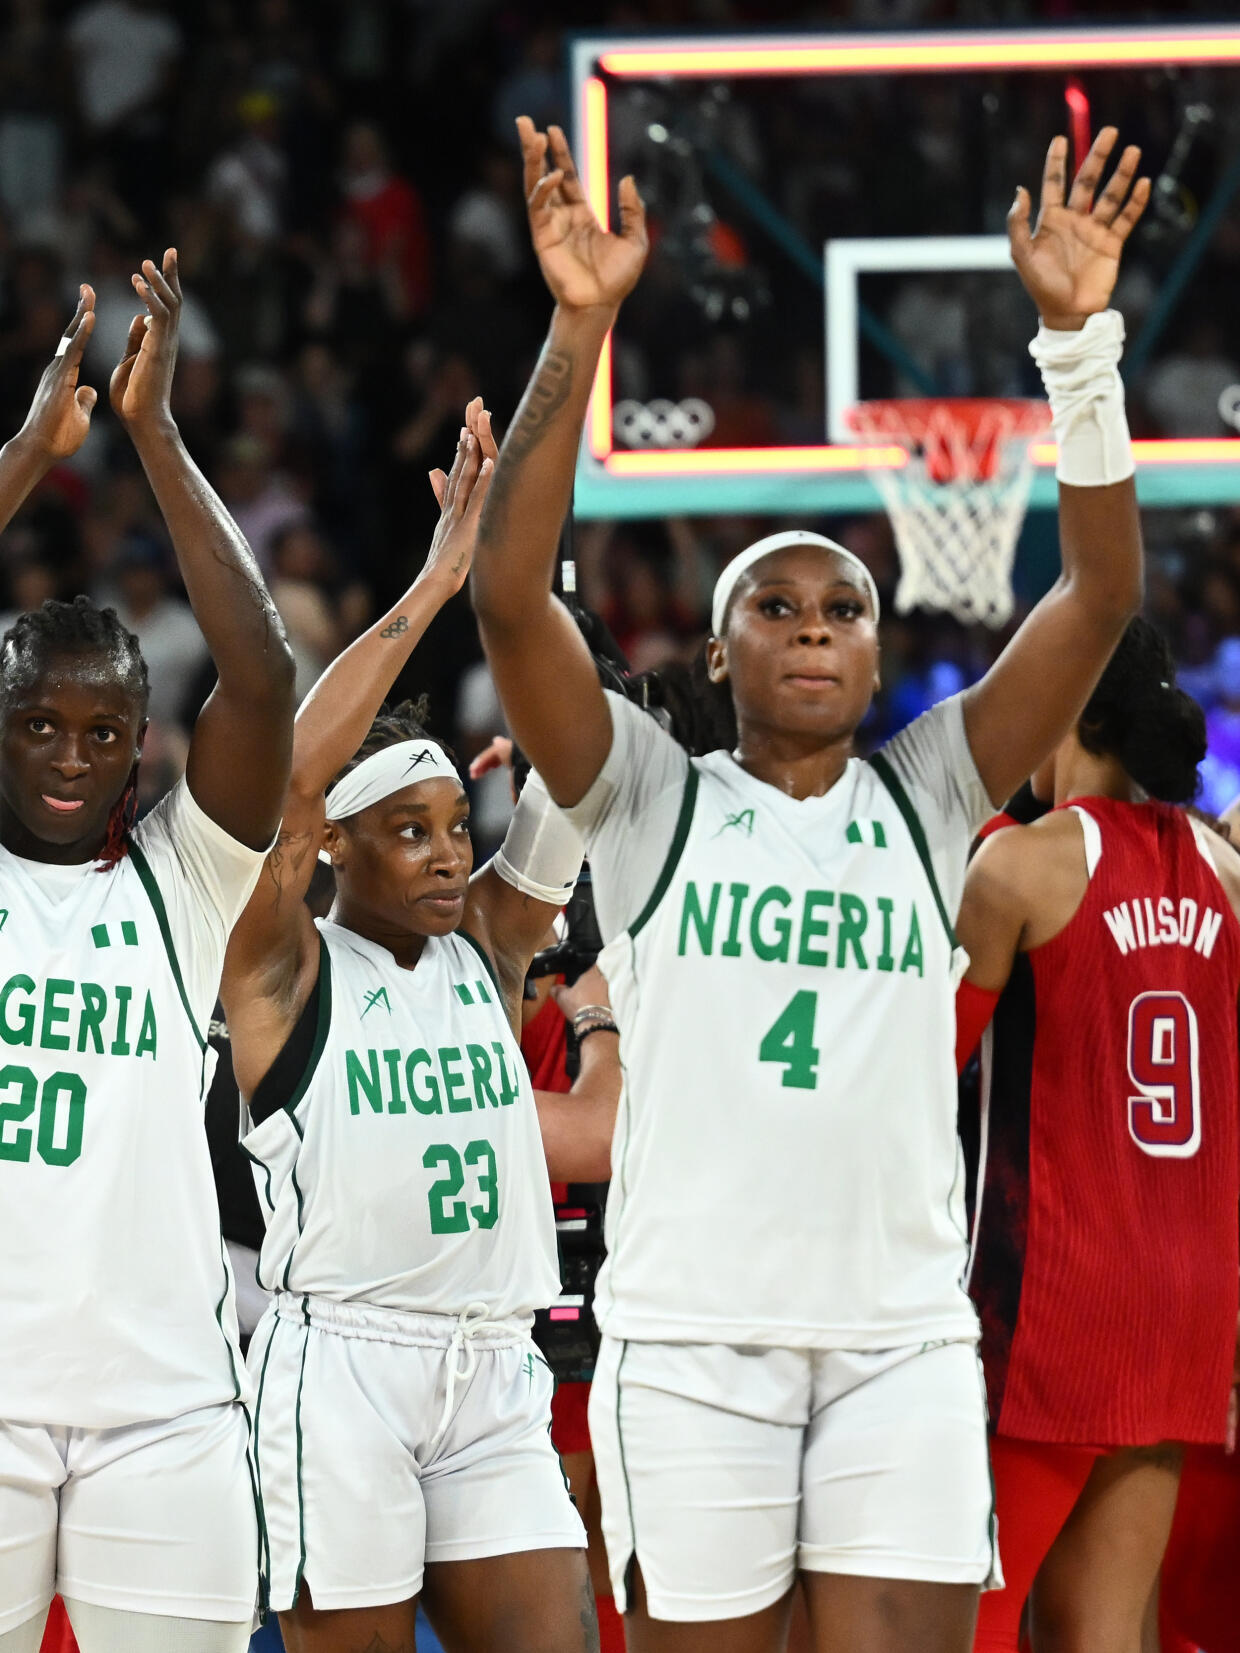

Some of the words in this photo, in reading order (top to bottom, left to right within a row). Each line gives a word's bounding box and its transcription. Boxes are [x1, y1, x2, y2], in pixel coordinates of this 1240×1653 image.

[677, 881, 924, 978] NIGERIA
[1103, 897, 1223, 958] WILSON
[758, 989, 819, 1089] 4
[1127, 990, 1202, 1158] 9
[422, 1139, 499, 1235] 23
